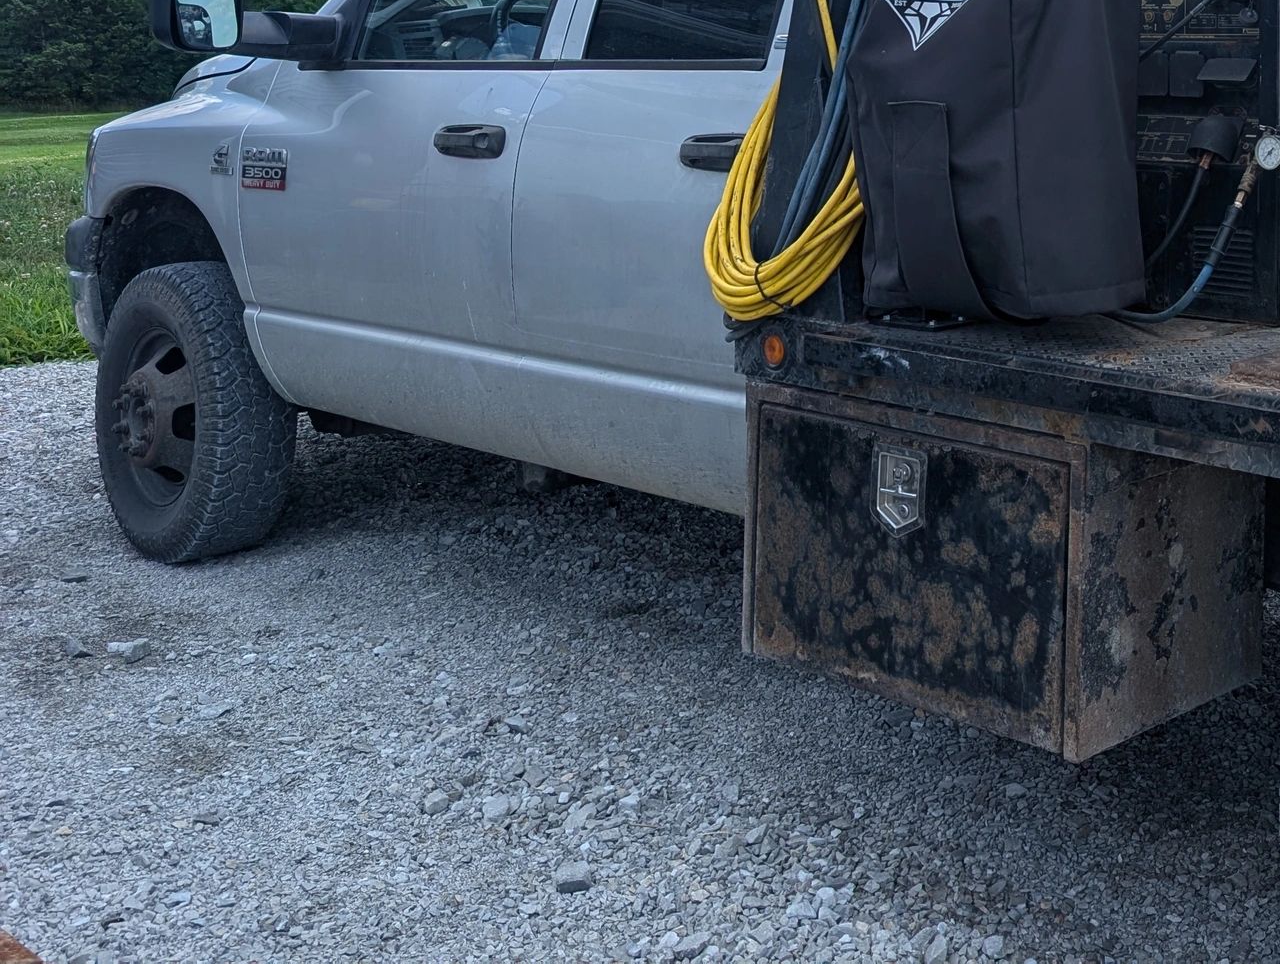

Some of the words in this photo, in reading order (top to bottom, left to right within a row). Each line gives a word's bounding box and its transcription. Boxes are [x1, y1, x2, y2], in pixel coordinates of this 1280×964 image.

[245, 168, 281, 179] 3500
[244, 179, 264, 187] HEAVY
[265, 180, 281, 188] DUTY
